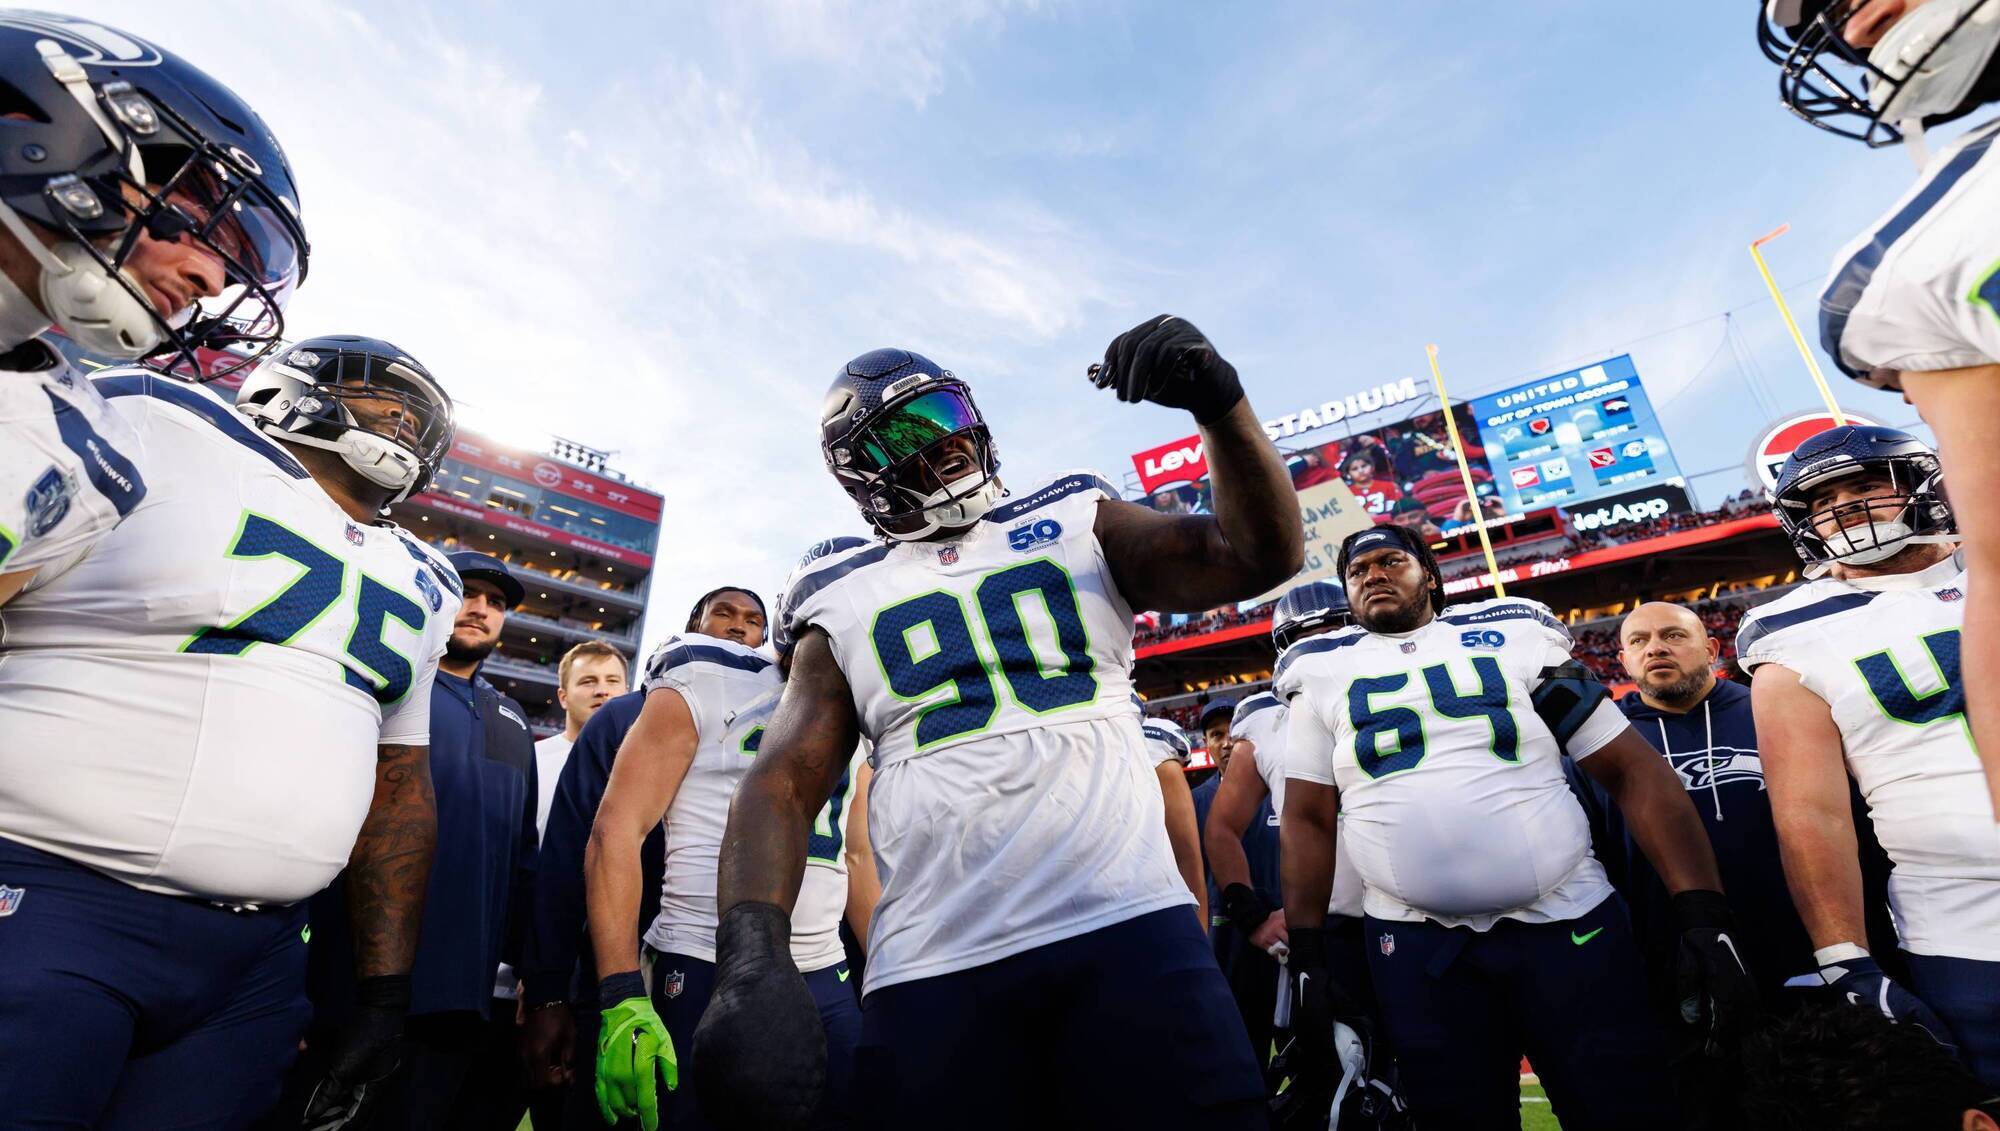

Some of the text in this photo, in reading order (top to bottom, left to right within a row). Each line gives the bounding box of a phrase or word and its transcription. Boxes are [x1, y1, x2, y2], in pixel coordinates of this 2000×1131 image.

[1262, 377, 1418, 441] STADIUM
[1487, 380, 1630, 427] OUT OF TOWN SCORES
[1496, 377, 1579, 408] UNITED
[1012, 480, 1082, 513] SEAHAWKS
[1007, 518, 1063, 552] 50
[1530, 558, 1572, 578] Tito's
[175, 507, 431, 704] 75
[1469, 608, 1532, 621] SEAHAWKS
[868, 556, 1102, 752] 90
[1461, 630, 1506, 648] 50
[1345, 656, 1521, 781] 64
